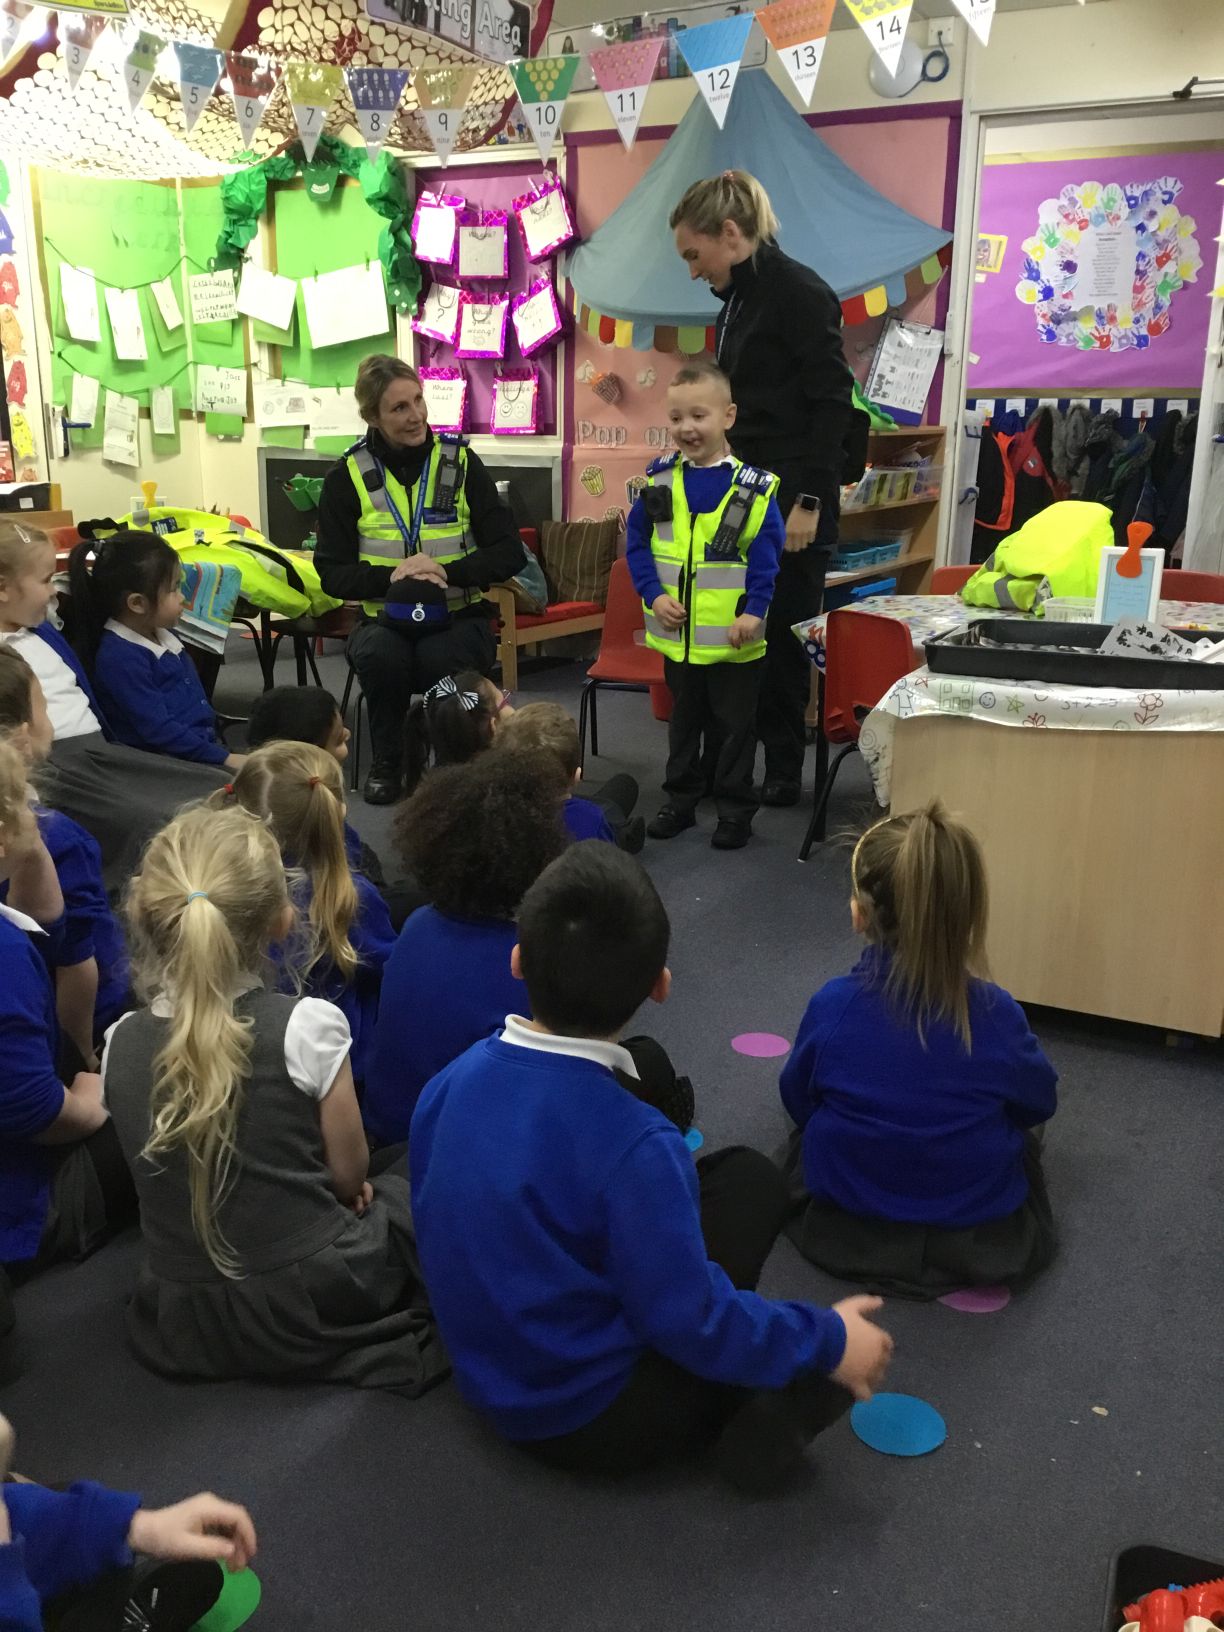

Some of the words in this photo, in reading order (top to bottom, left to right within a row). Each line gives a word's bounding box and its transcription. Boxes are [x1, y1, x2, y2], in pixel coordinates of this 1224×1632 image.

[478, 3, 521, 47] Area
[876, 15, 902, 41] 14
[71, 47, 80, 65] 3
[792, 45, 817, 70] 13
[131, 70, 141, 87] 4
[708, 68, 731, 92] 12
[189, 86, 199, 104] 5
[617, 91, 637, 113] 11
[244, 101, 254, 118] 6
[305, 107, 315, 126] 7
[535, 104, 556, 126] 10
[370, 112, 380, 132] 8
[438, 112, 449, 131] 9
[577, 419, 627, 447] Pop
